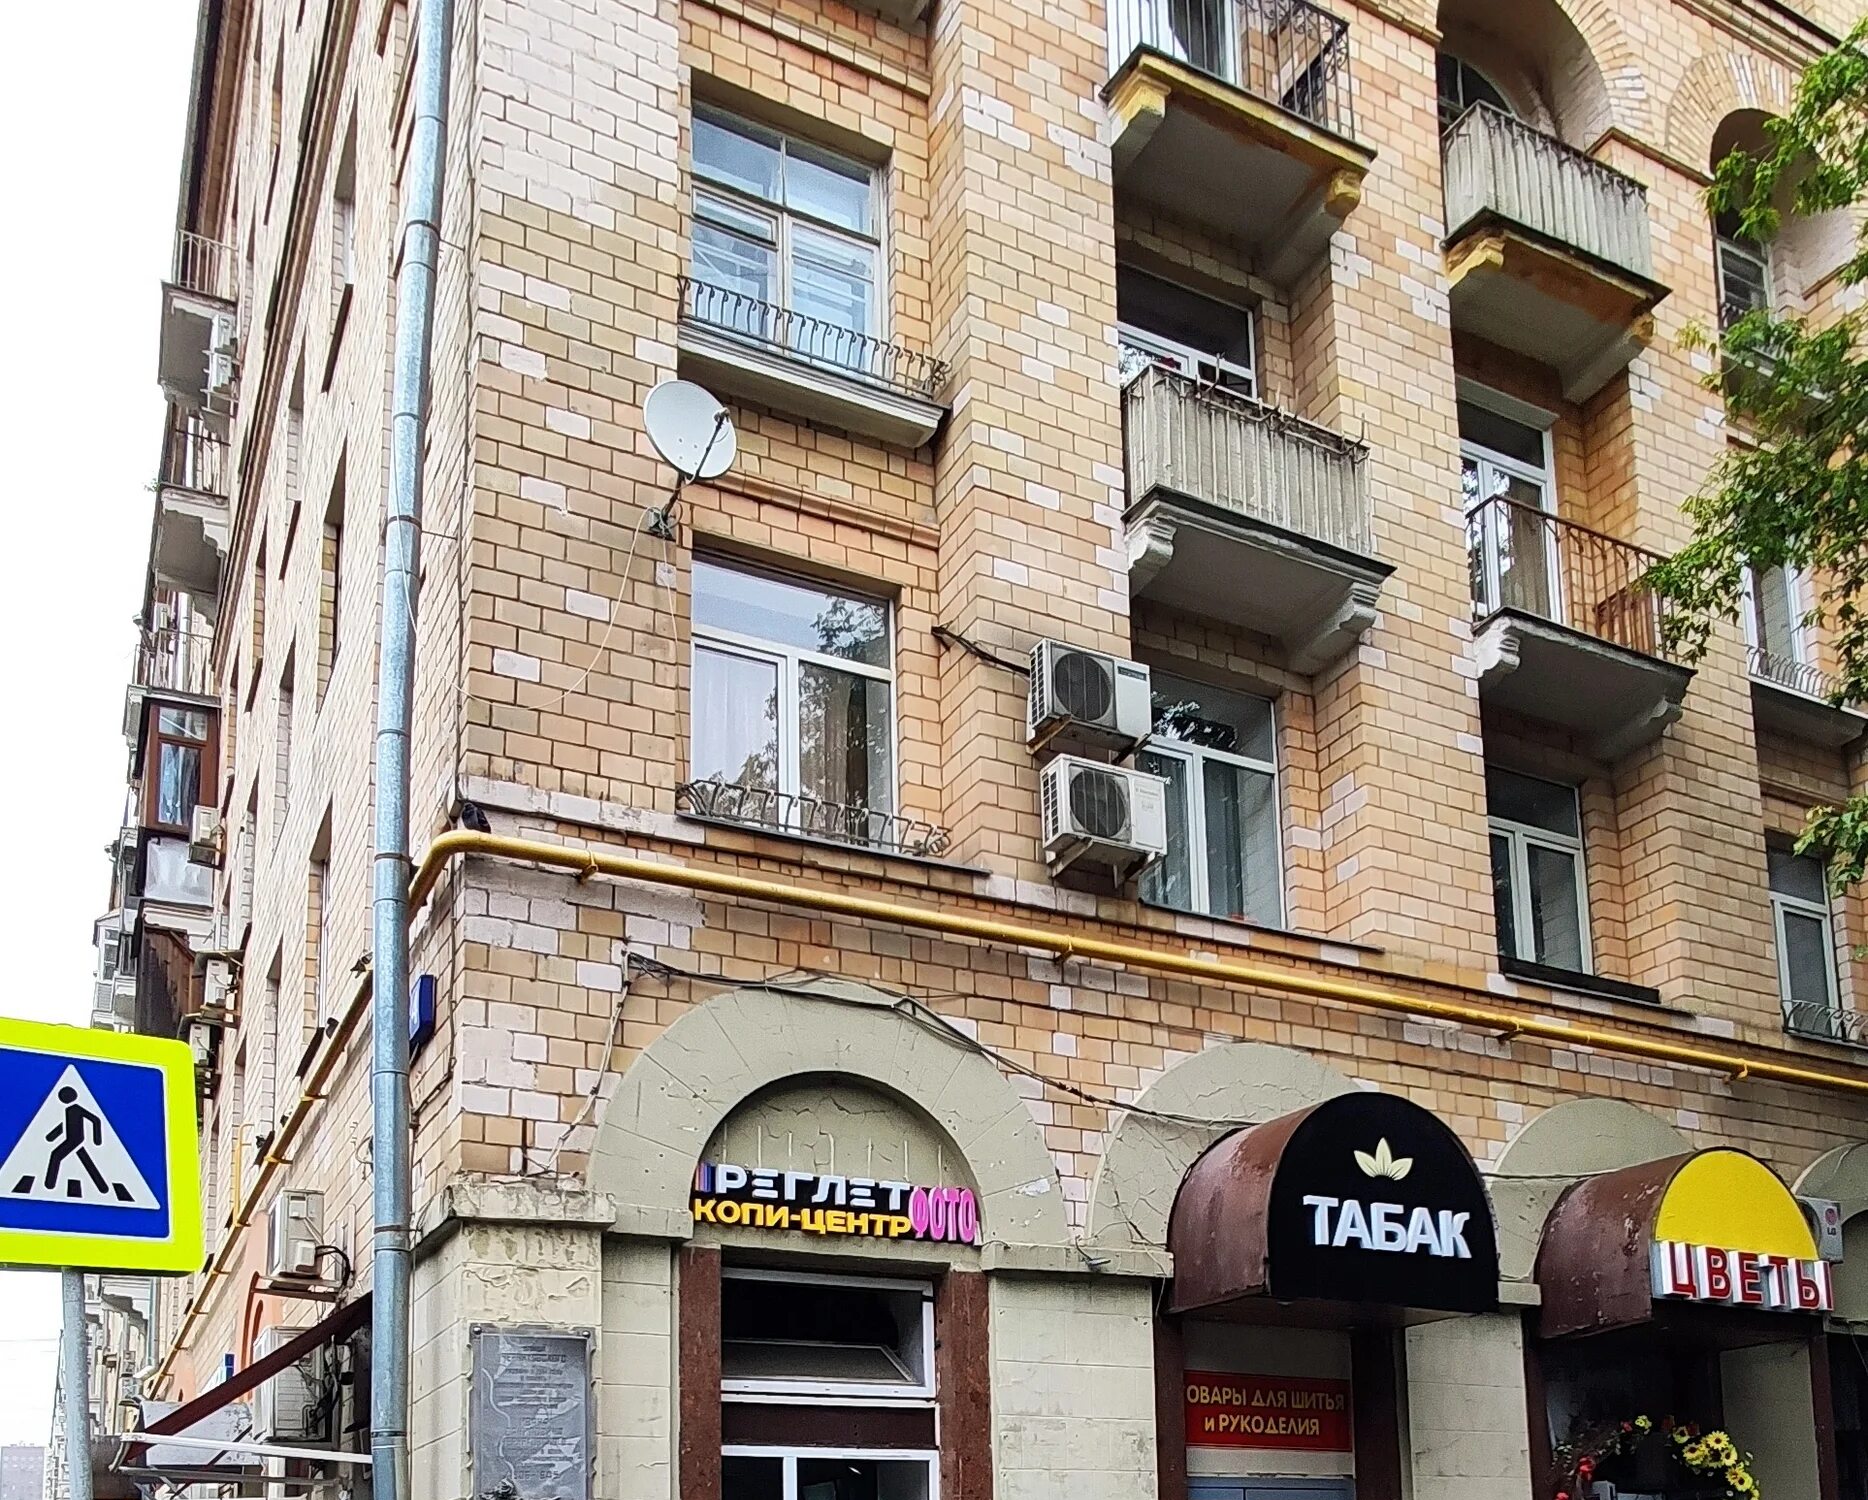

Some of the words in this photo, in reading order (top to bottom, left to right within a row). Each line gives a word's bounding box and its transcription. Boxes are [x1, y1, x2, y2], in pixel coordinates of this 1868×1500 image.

[716, 1163, 910, 1211] РЕГЛЕТ
[695, 1198, 911, 1237] КОПИ-ЦЕНТР
[908, 1186, 976, 1243] ФОТО
[1303, 1194, 1472, 1258] ТАБАК
[1827, 1226, 1837, 1236] LG
[1660, 1240, 1834, 1311] ЦВЕТЫ
[1186, 1385, 1247, 1407] ОВАРЫ
[1251, 1389, 1287, 1409] ДЛЯ
[1291, 1391, 1345, 1411] ШИТЬЯ
[1218, 1413, 1320, 1436] РУКОДЕЛИЯ
